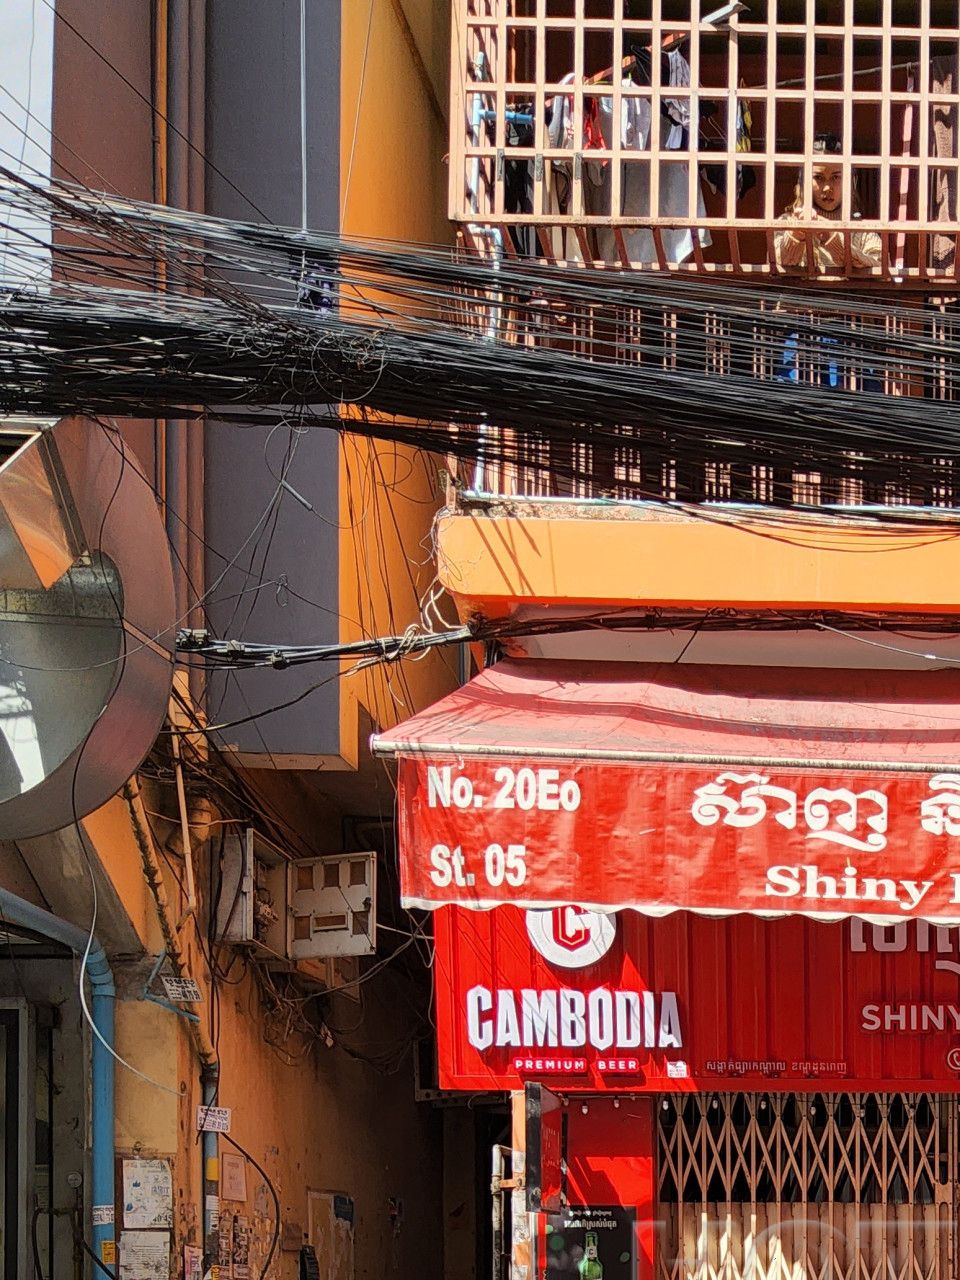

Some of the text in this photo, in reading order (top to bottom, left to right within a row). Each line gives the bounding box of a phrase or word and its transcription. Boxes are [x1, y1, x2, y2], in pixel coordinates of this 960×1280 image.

[427, 765, 581, 812] No. 20Eo
[430, 843, 527, 887] St. 05
[765, 865, 934, 910] Shiny
[466, 984, 683, 1051] CAMBODIA
[515, 1059, 637, 1070] PREMIUM BEER
